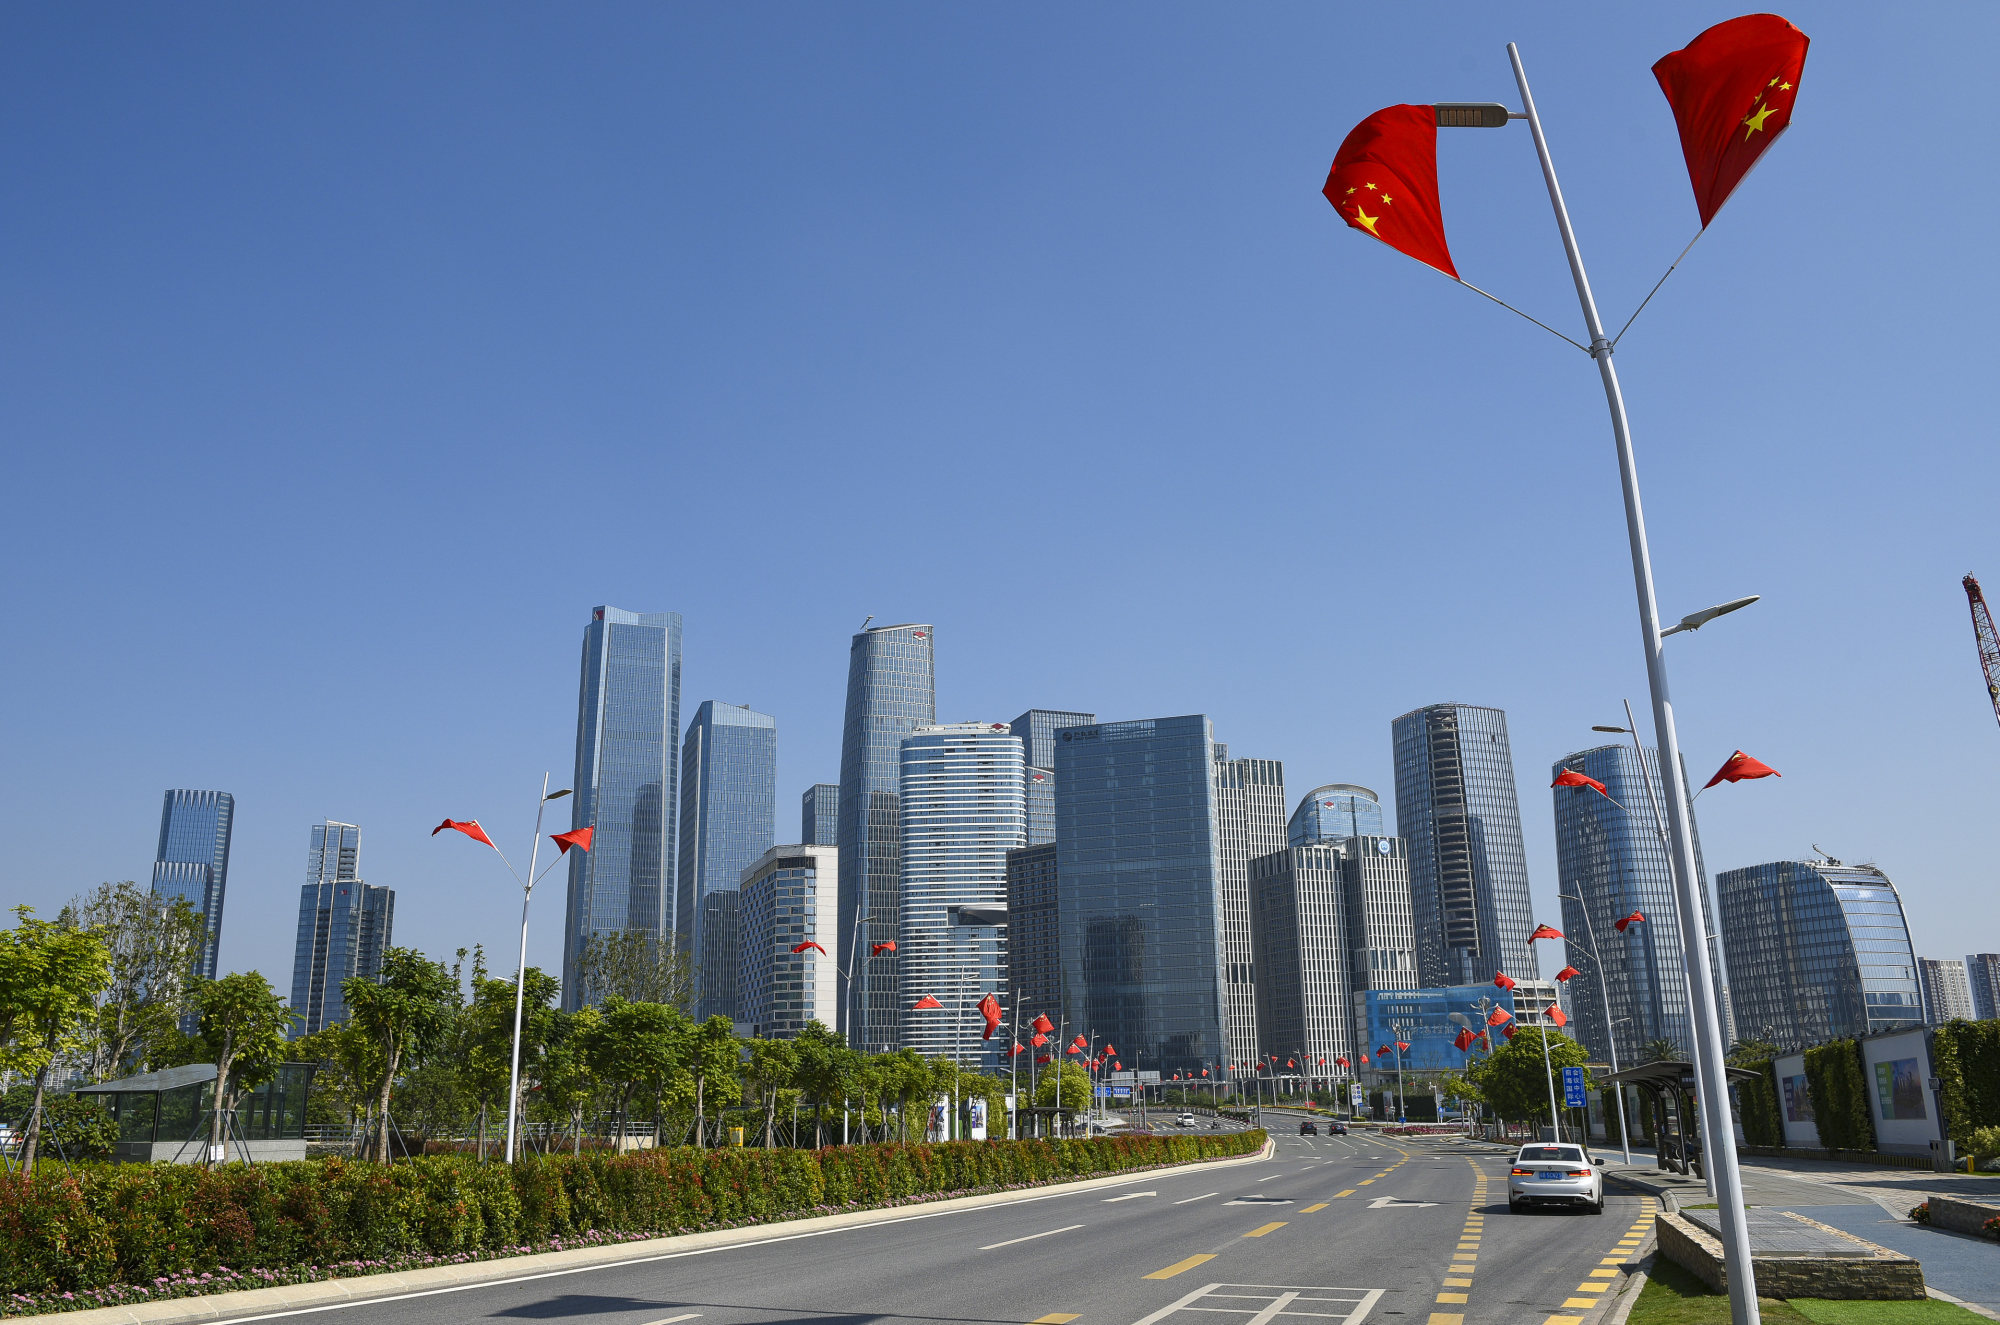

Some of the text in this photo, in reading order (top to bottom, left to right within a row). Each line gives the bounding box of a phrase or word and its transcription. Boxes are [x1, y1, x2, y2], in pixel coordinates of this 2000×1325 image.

[1565, 1069, 1574, 1100] 前海国际
[1572, 1069, 1581, 1100] 会议中心
